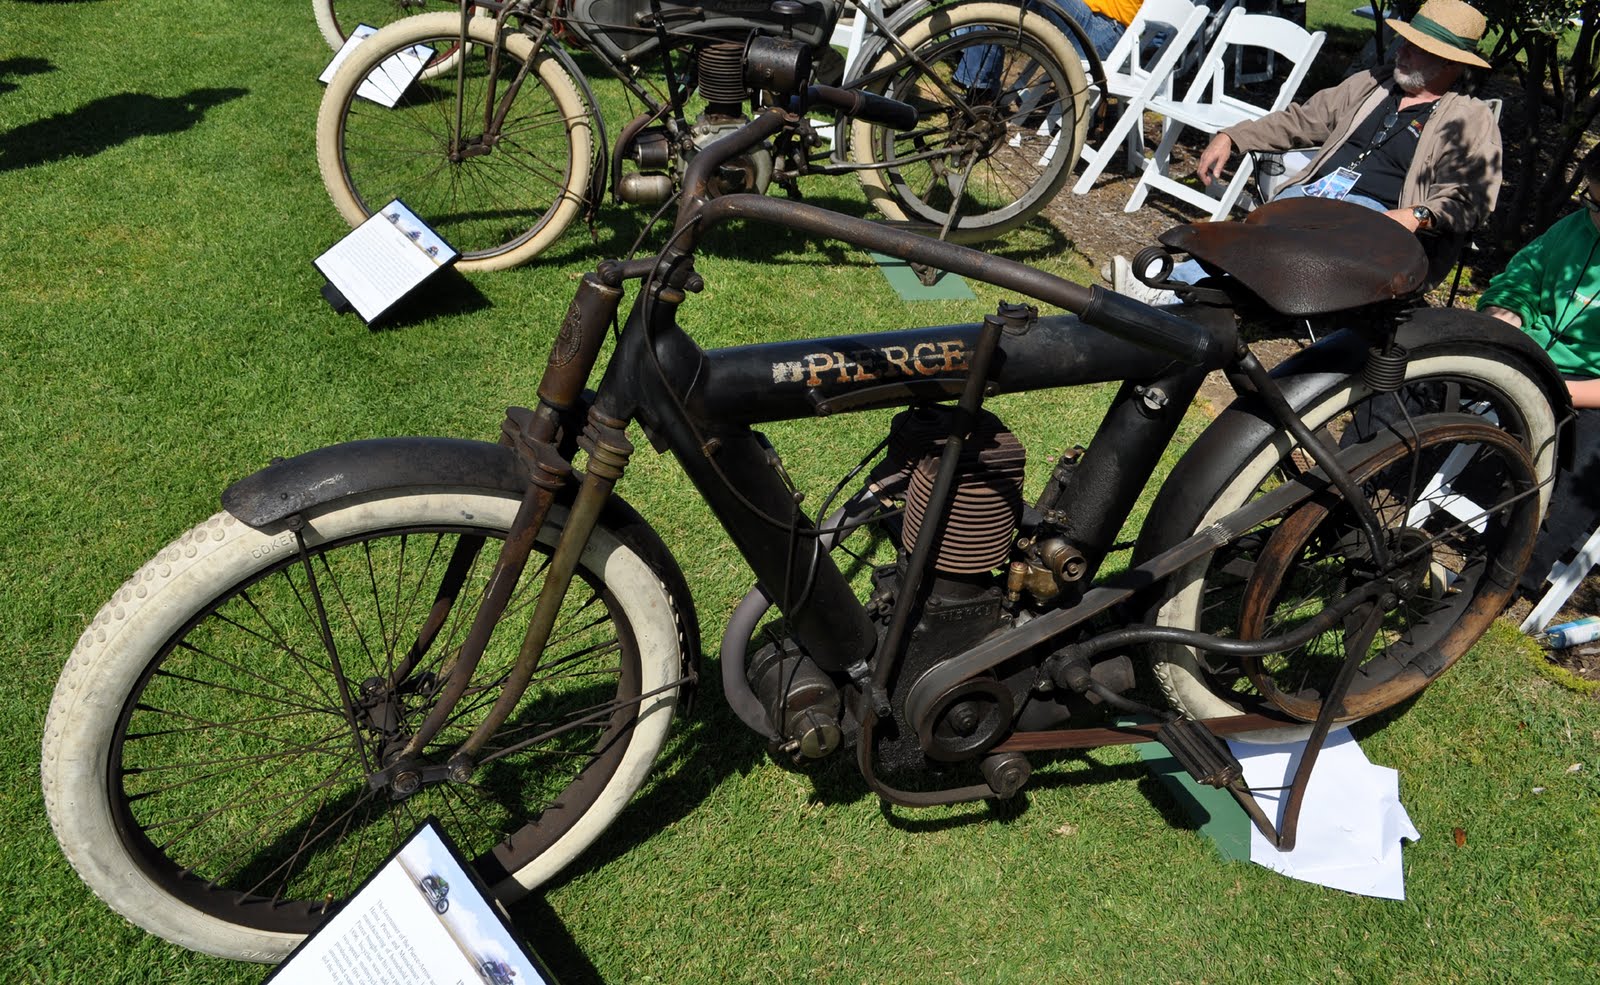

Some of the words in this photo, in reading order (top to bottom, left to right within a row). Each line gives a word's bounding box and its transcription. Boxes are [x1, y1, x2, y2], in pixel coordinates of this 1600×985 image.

[803, 339, 968, 386] PIERCE
[381, 922, 392, 939] Pierce
[391, 940, 400, 950] and
[408, 946, 430, 979] Pierce-Arrow
